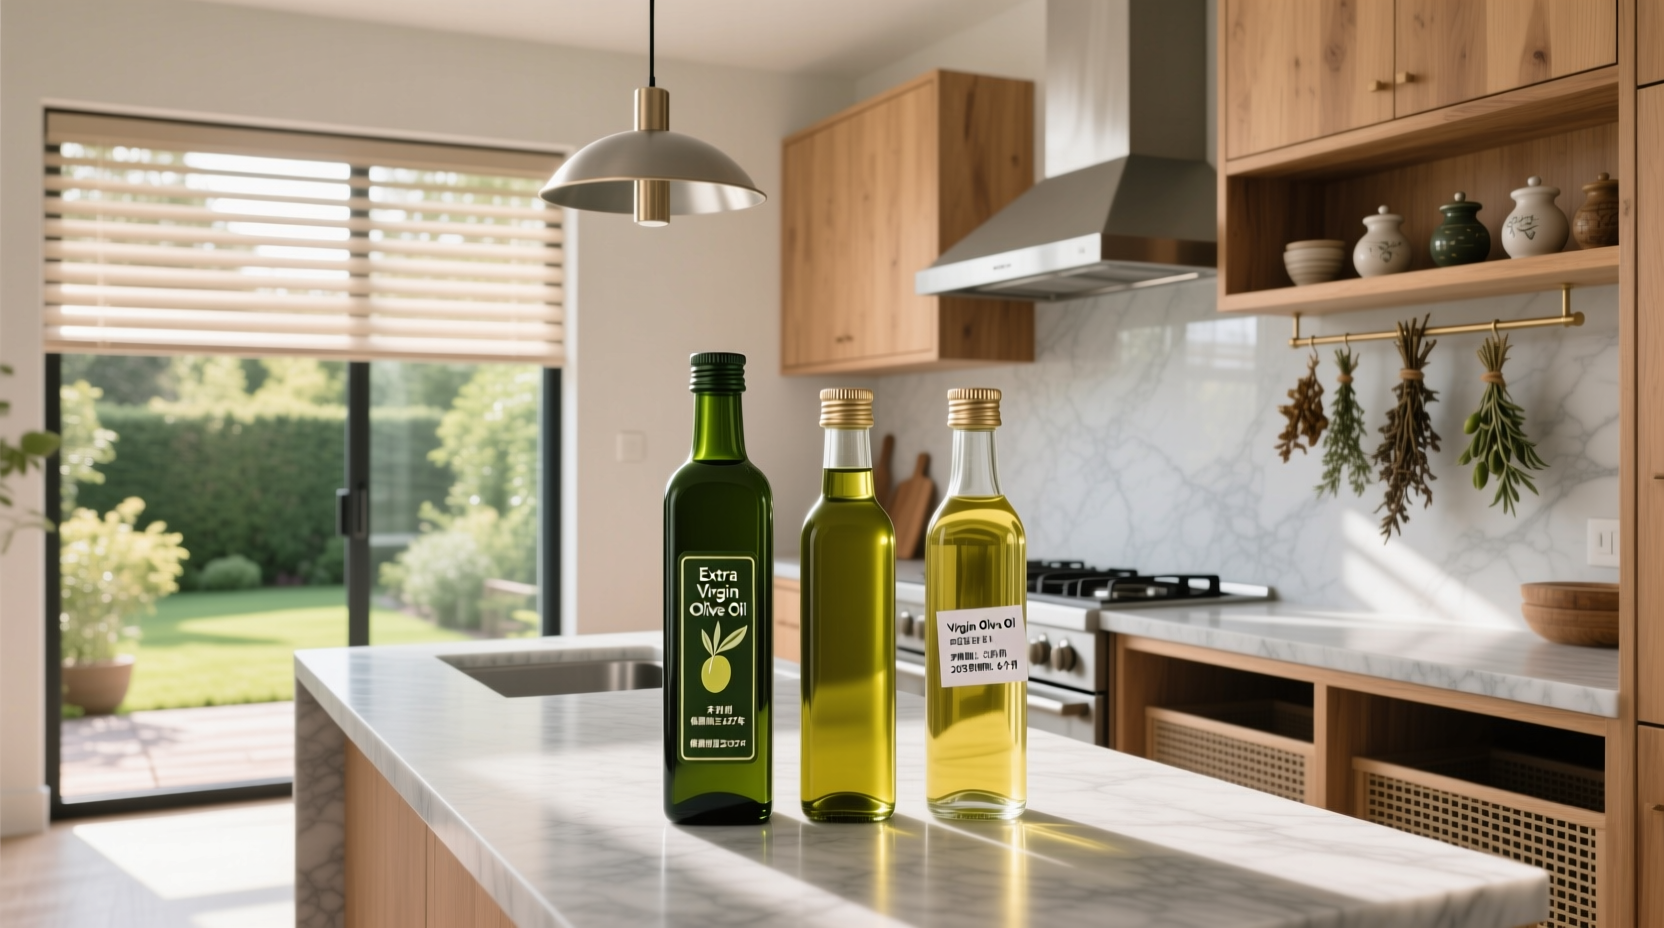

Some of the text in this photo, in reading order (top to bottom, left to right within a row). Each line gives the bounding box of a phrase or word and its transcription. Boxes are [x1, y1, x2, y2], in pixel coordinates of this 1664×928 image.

[699, 567, 738, 582] Extra
[696, 583, 739, 603] Virgin
[689, 600, 747, 617] Olive Oil
[946, 621, 976, 634] Virgin
